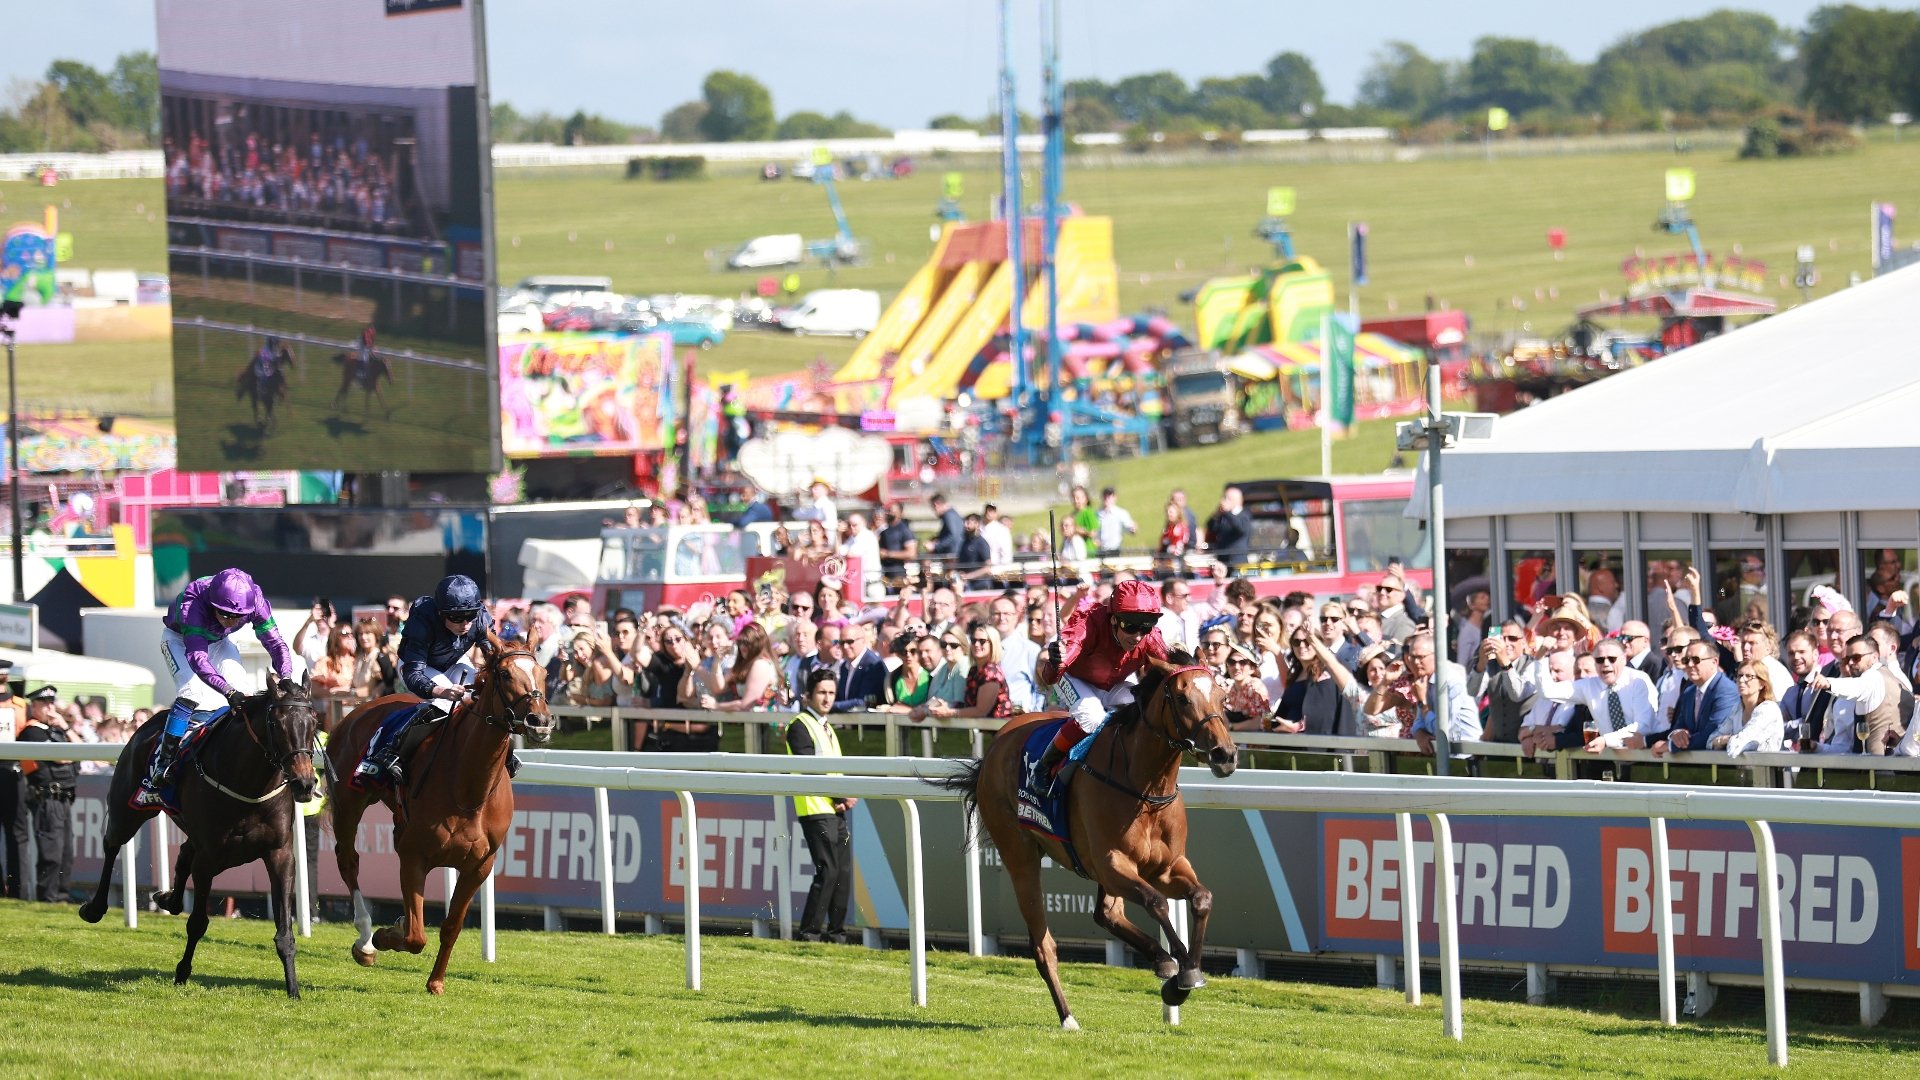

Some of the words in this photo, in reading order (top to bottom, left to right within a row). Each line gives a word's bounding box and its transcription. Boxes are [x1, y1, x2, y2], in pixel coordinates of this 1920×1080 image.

[494, 810, 642, 884] ETFRD
[669, 816, 818, 893] BETFRE
[1044, 893, 1096, 914] ESTIVA
